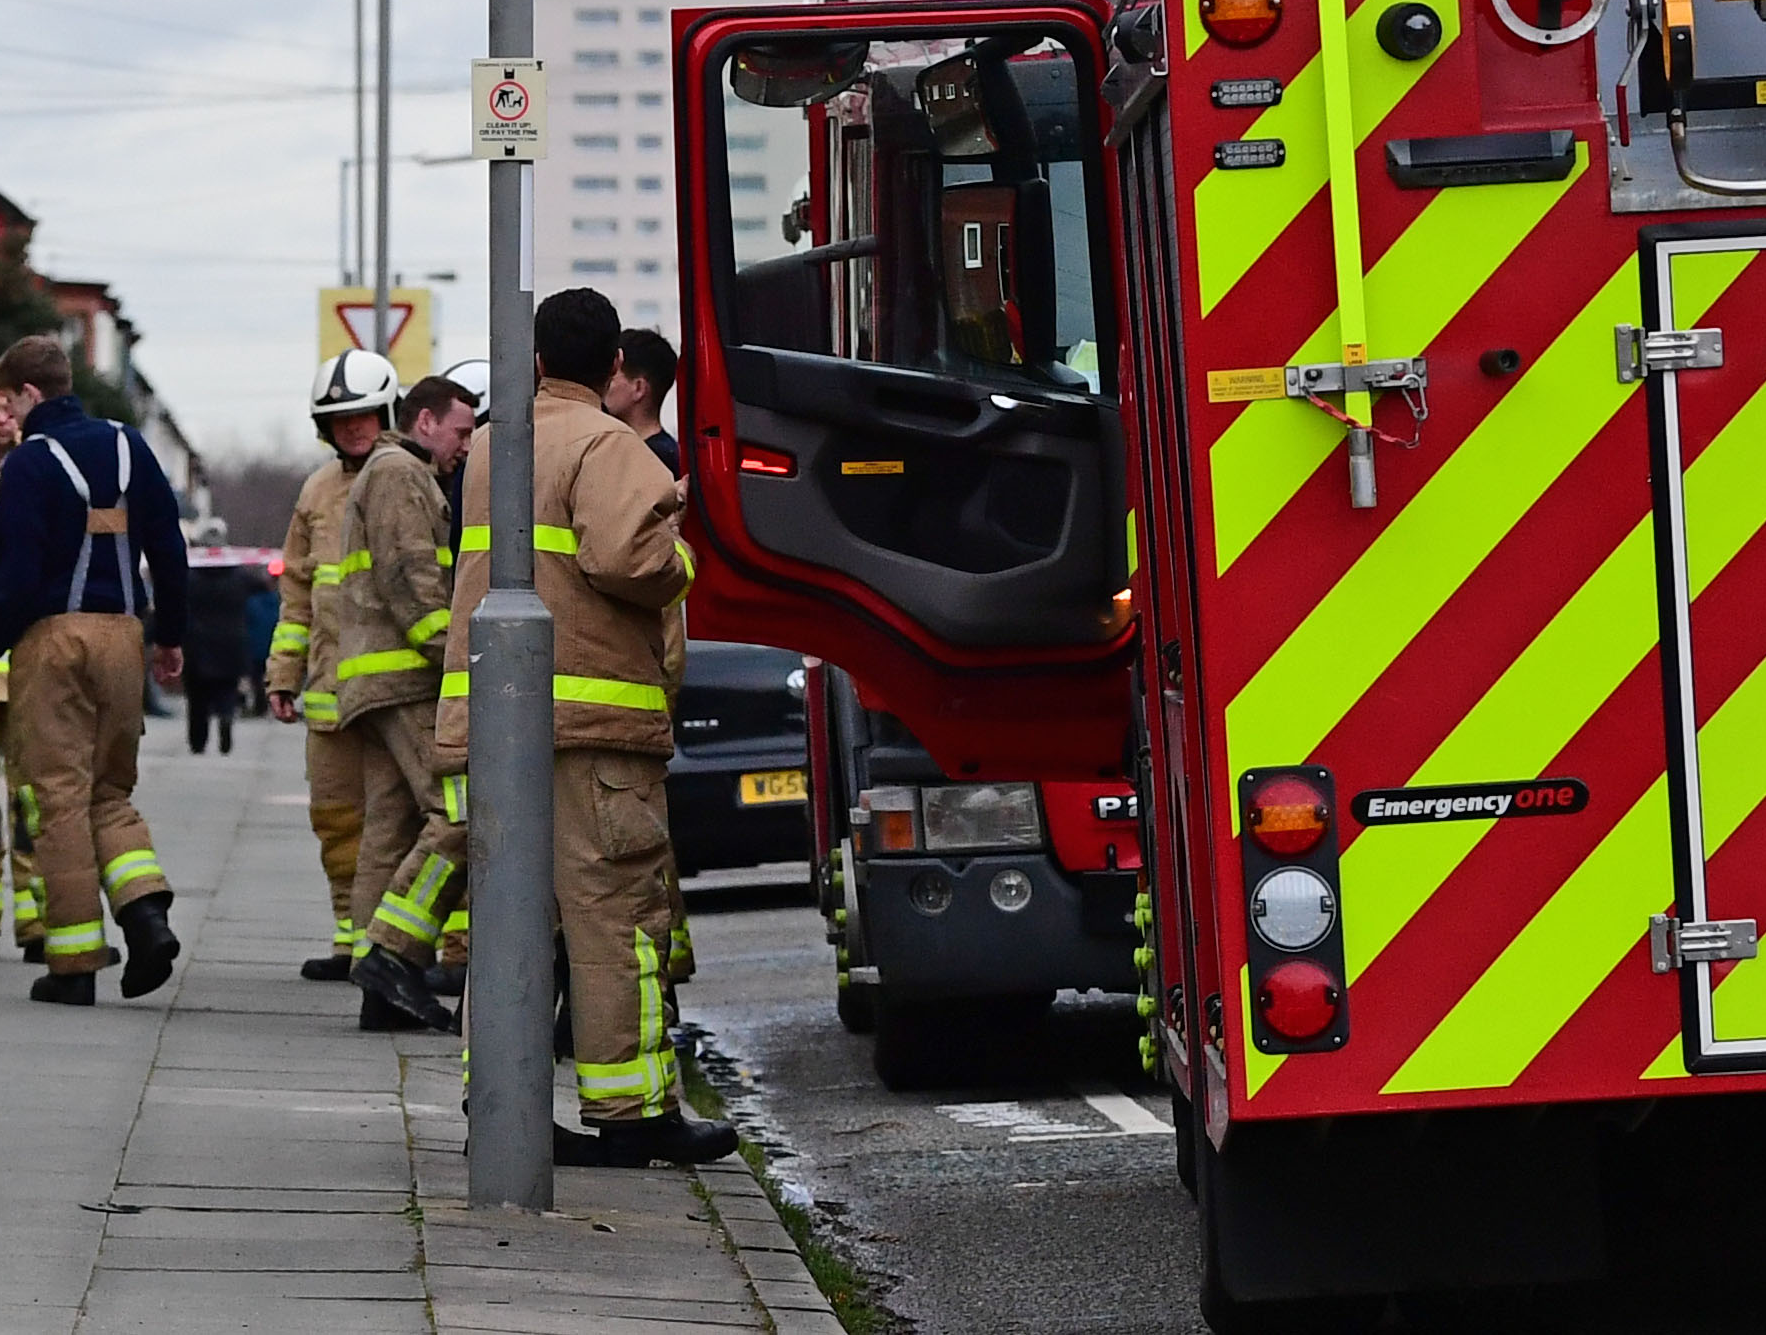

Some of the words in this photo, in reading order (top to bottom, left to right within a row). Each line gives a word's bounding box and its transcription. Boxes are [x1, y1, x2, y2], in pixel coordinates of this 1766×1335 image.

[753, 773, 807, 795] WG5
[1367, 793, 1512, 819] Emergency
[1515, 787, 1575, 808] one
